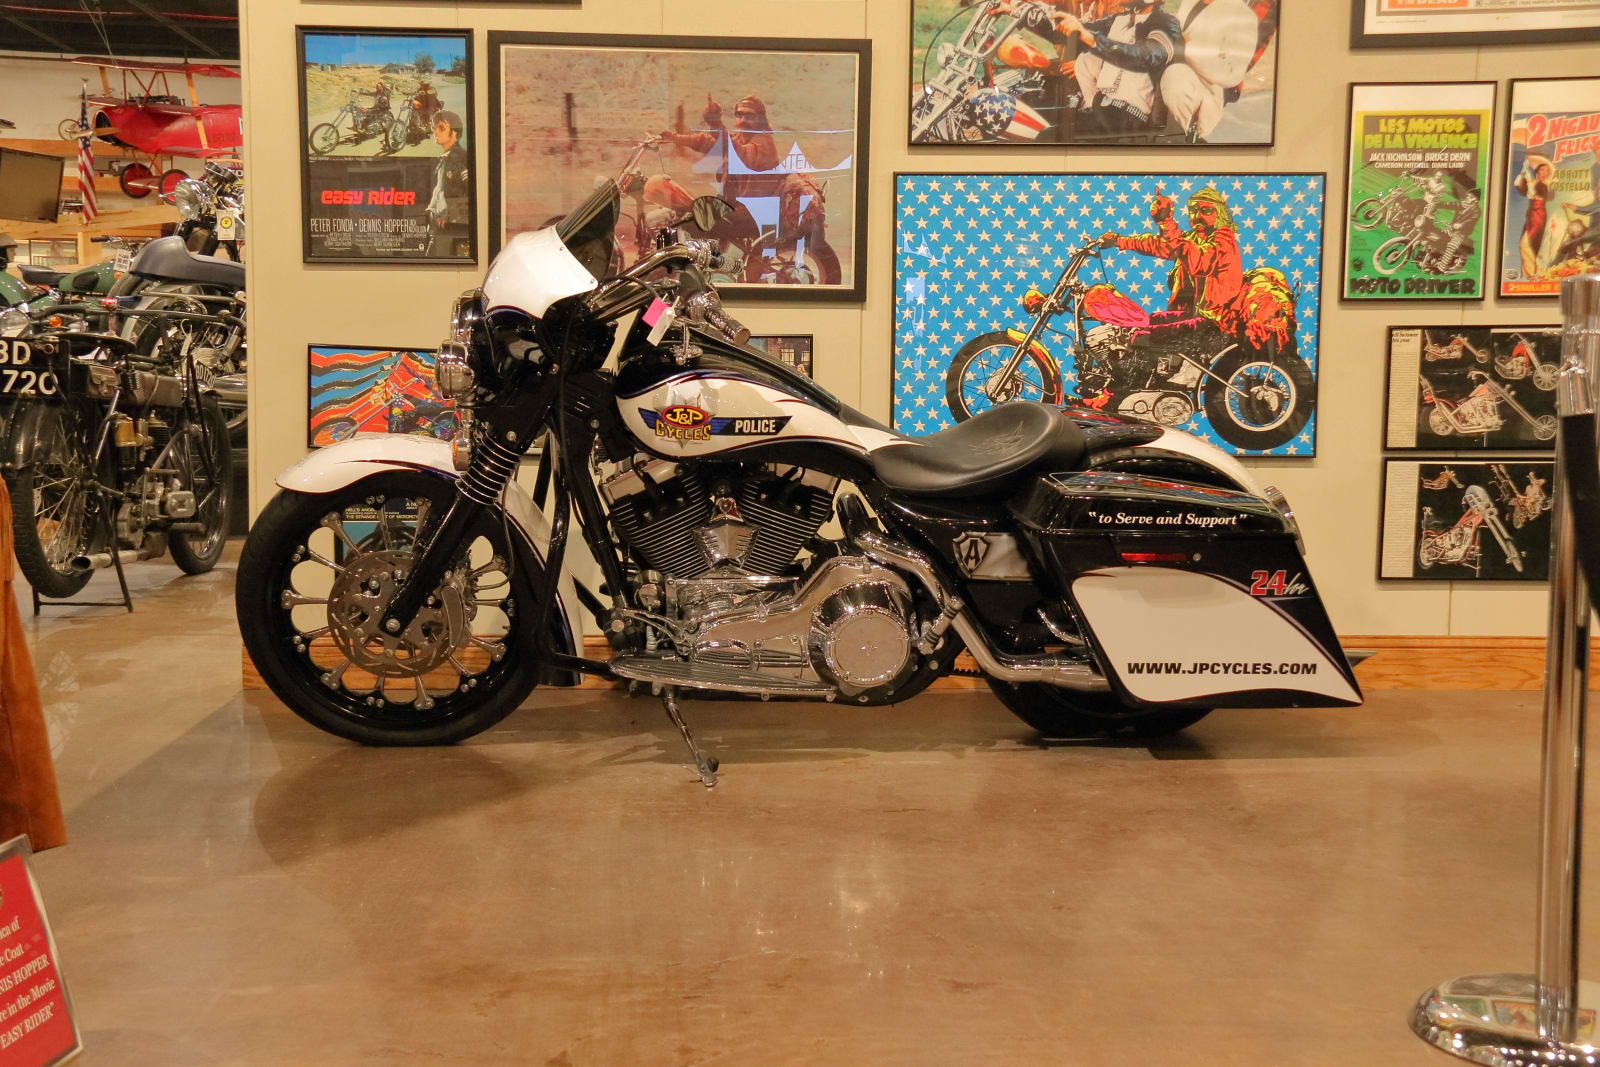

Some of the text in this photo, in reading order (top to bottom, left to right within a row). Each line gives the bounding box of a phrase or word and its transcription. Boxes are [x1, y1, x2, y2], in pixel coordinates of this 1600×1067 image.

[1379, 117, 1465, 133] LES MOTOS
[1527, 114, 1547, 148] 2
[1364, 133, 1478, 149] DE LA VIOLENCE
[1370, 152, 1471, 162] JACK NICHOLSON BRUCE DERN
[321, 190, 363, 205] easy
[310, 218, 330, 232] PETER
[333, 218, 354, 232] FONDA
[359, 218, 382, 232] DENNIS
[384, 218, 409, 232] HOPPER
[1350, 277, 1476, 294] MOTO DRIVER
[666, 408, 703, 424] J&P
[655, 419, 712, 440] CYCLES
[735, 419, 776, 434] POLICE
[1115, 512, 1153, 525] Serve
[1156, 513, 1182, 525] and
[1127, 662, 1318, 675] WWW.JPCYCLES.COM
[11, 915, 21, 932] of
[5, 943, 25, 962] Coat
[13, 953, 50, 985] HOPPER
[7, 1001, 18, 1017] in
[17, 993, 31, 1010] the
[31, 977, 56, 1004] Movie
[1, 1020, 24, 1050] EASY
